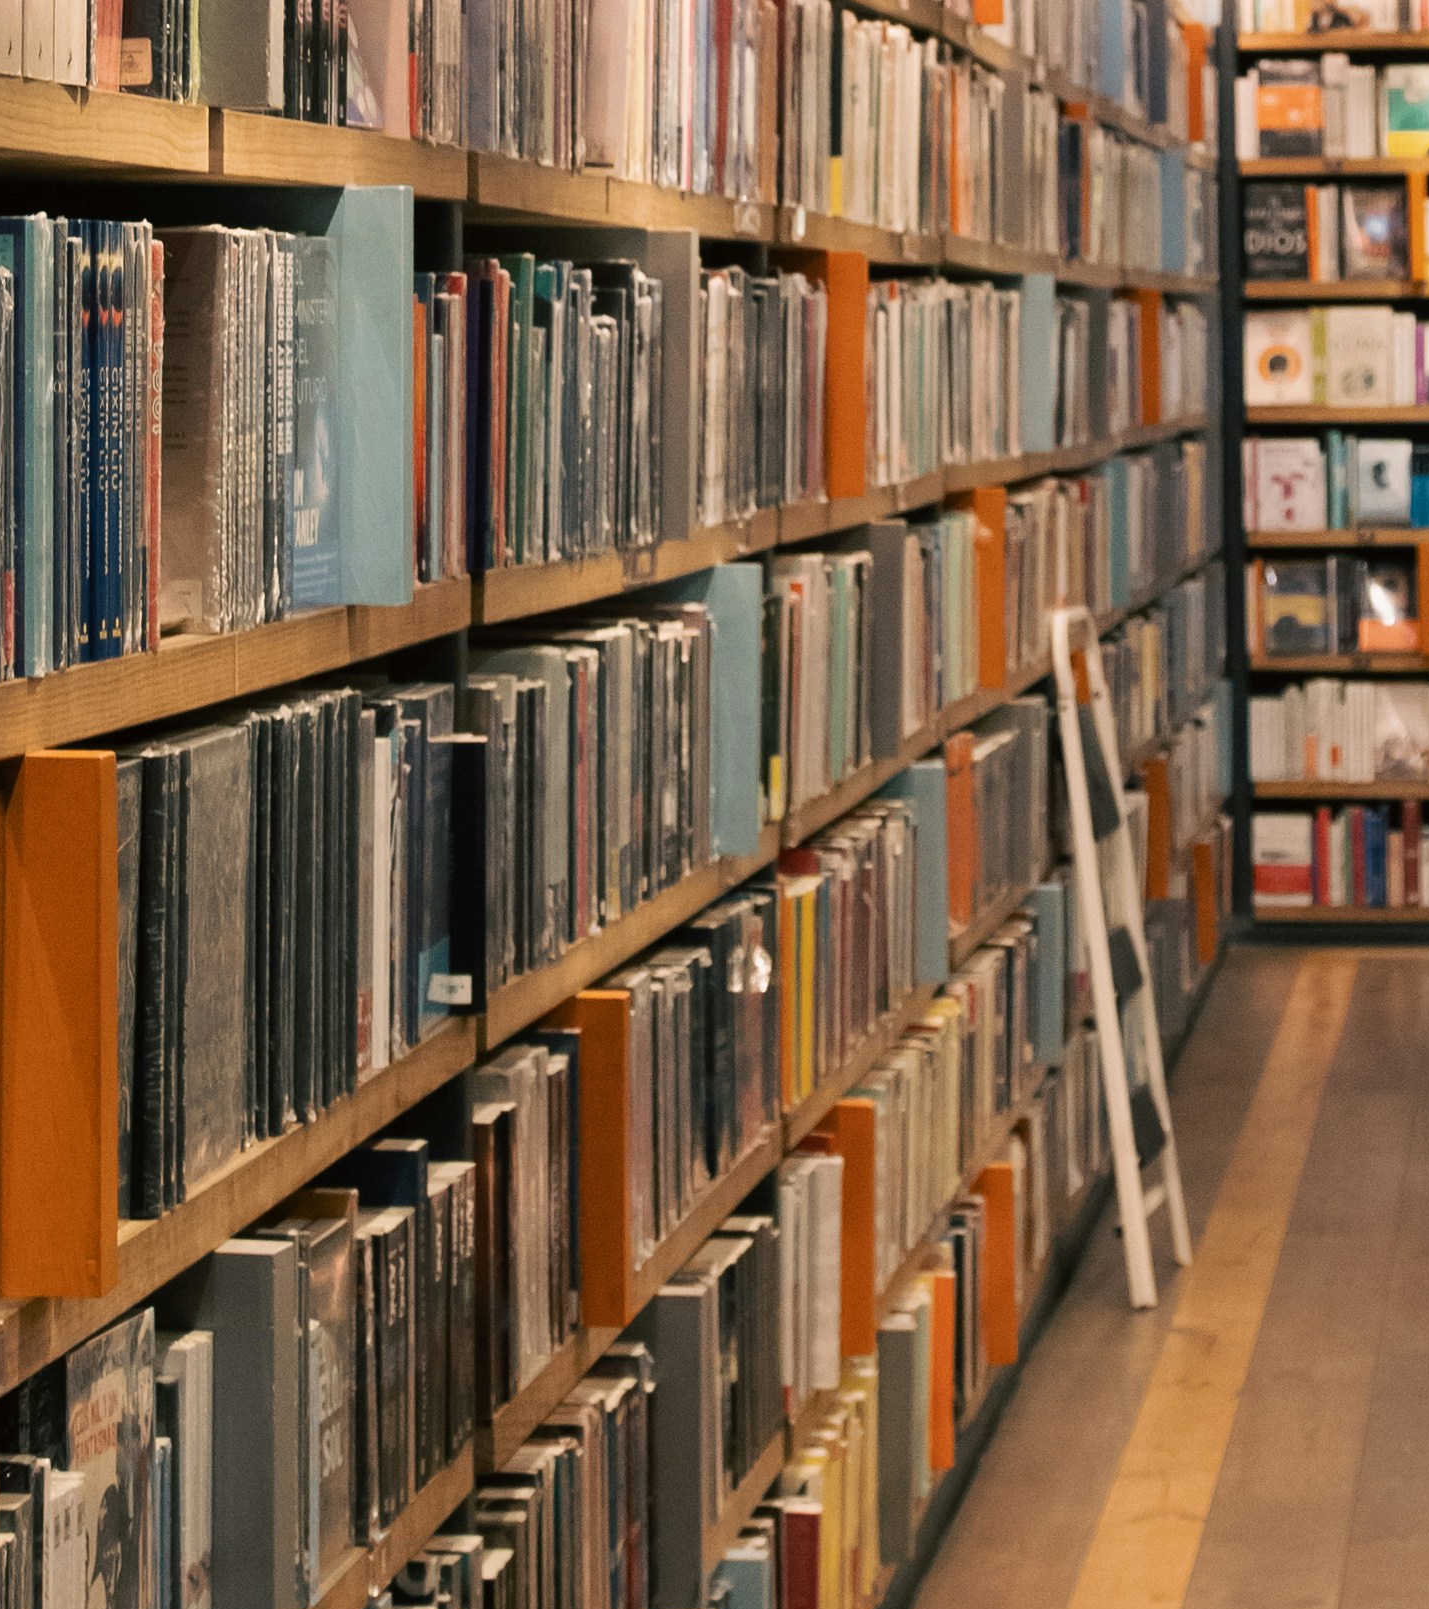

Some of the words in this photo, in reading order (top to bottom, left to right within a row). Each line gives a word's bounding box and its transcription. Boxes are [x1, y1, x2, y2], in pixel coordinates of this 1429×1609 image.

[277, 251, 286, 341] ROBINSON
[285, 252, 294, 341] ROBINSON
[277, 344, 285, 418] STANLEY
[285, 344, 294, 418] STANLEY
[277, 422, 285, 455] KIM
[285, 421, 293, 454] KIM
